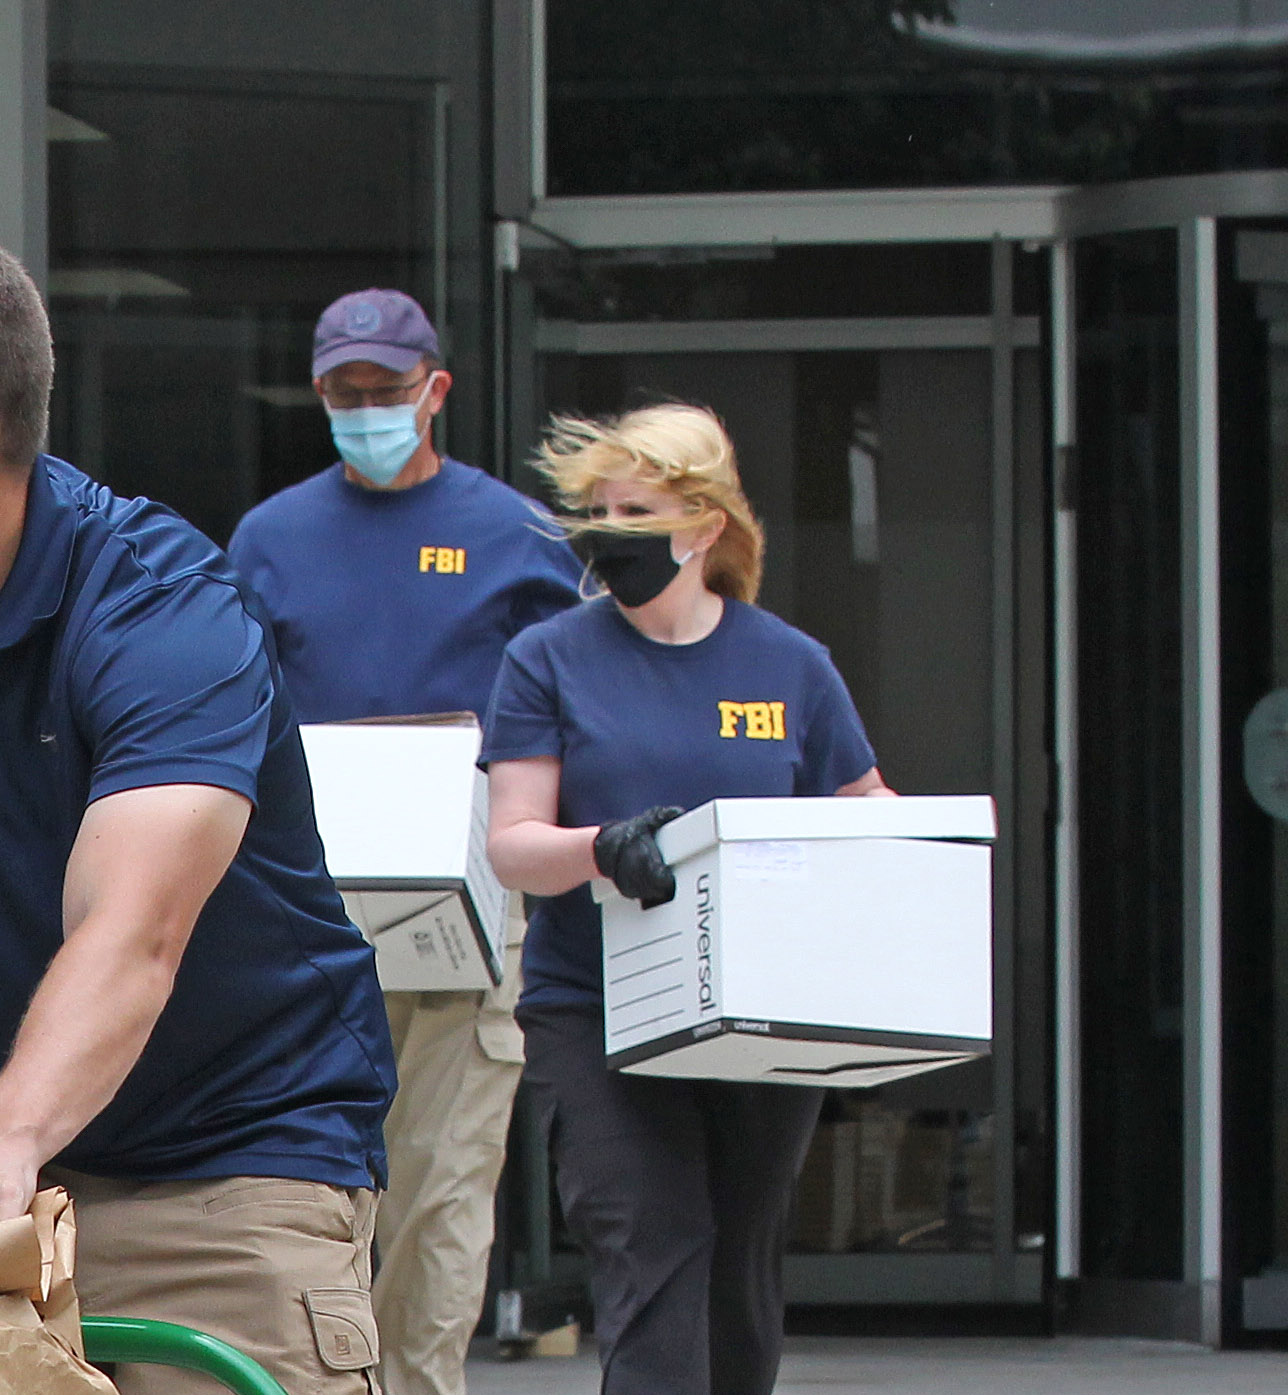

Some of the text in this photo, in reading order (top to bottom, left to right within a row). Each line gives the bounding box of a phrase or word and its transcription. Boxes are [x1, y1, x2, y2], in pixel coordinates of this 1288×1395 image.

[419, 546, 466, 575] FBI
[718, 701, 785, 740] FBI
[696, 873, 716, 1012] universal
